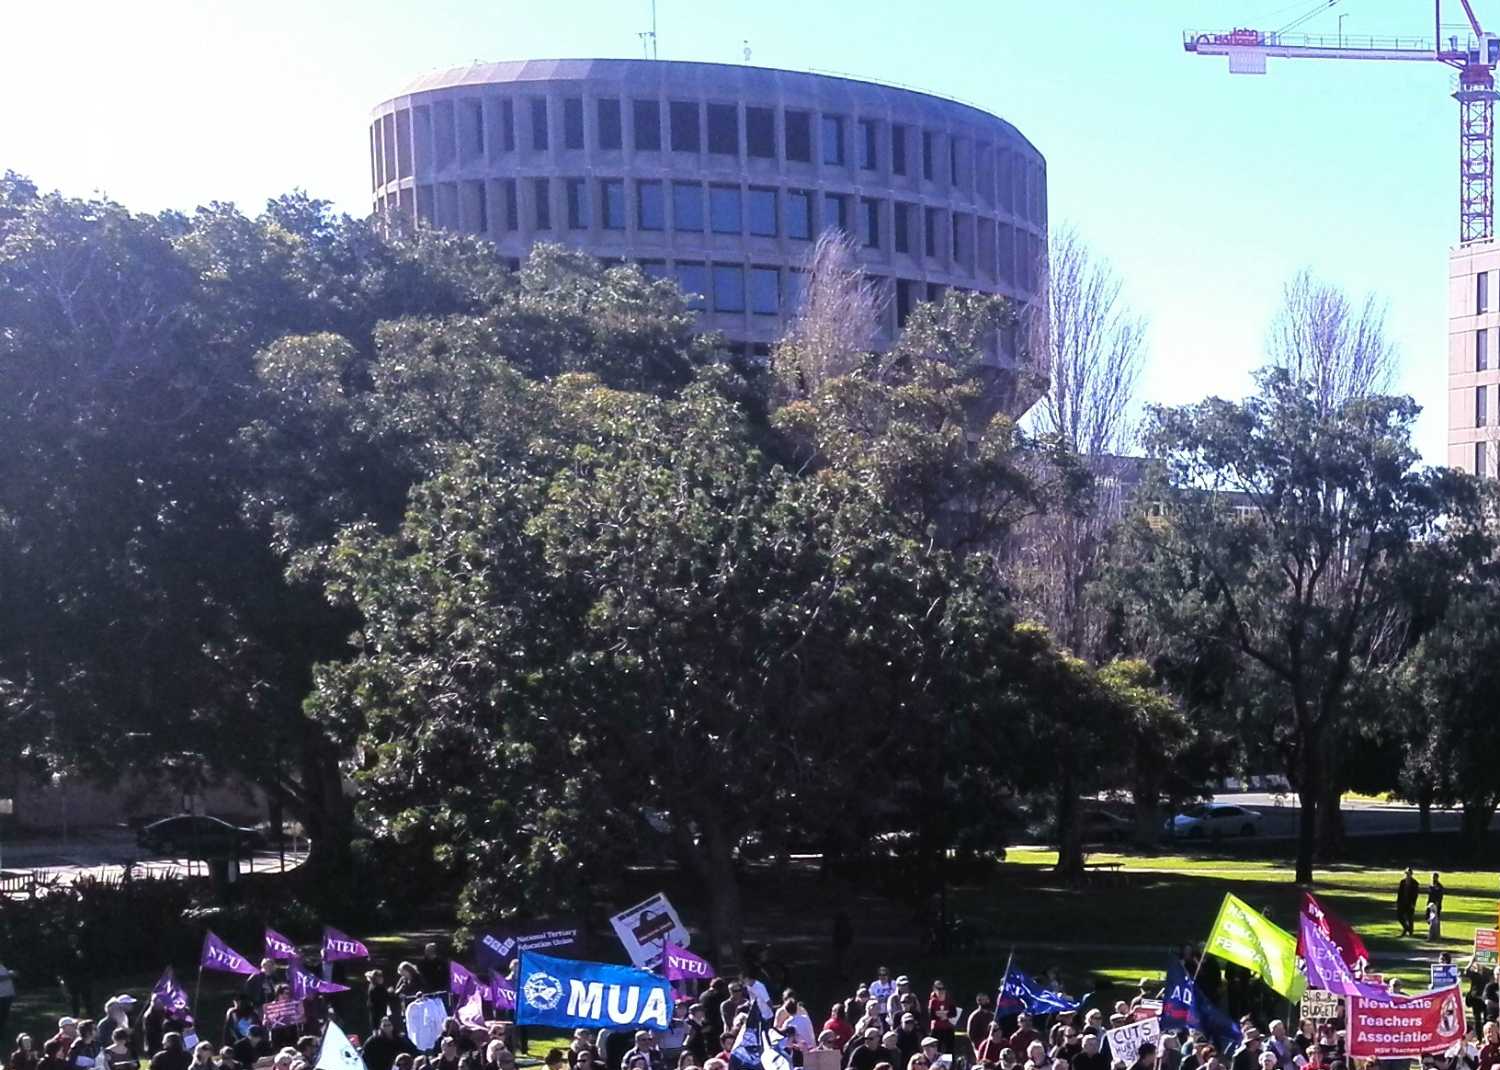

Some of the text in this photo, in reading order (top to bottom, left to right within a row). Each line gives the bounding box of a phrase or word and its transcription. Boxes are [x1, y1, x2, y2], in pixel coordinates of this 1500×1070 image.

[326, 936, 360, 955] NTEU
[208, 944, 242, 970] NTEU
[668, 955, 708, 976] NTEU
[566, 979, 668, 1028] MUA
[1302, 1003, 1336, 1018] BUDGET
[1358, 1014, 1423, 1027] Teachers
[1113, 1022, 1152, 1045] CUTS
